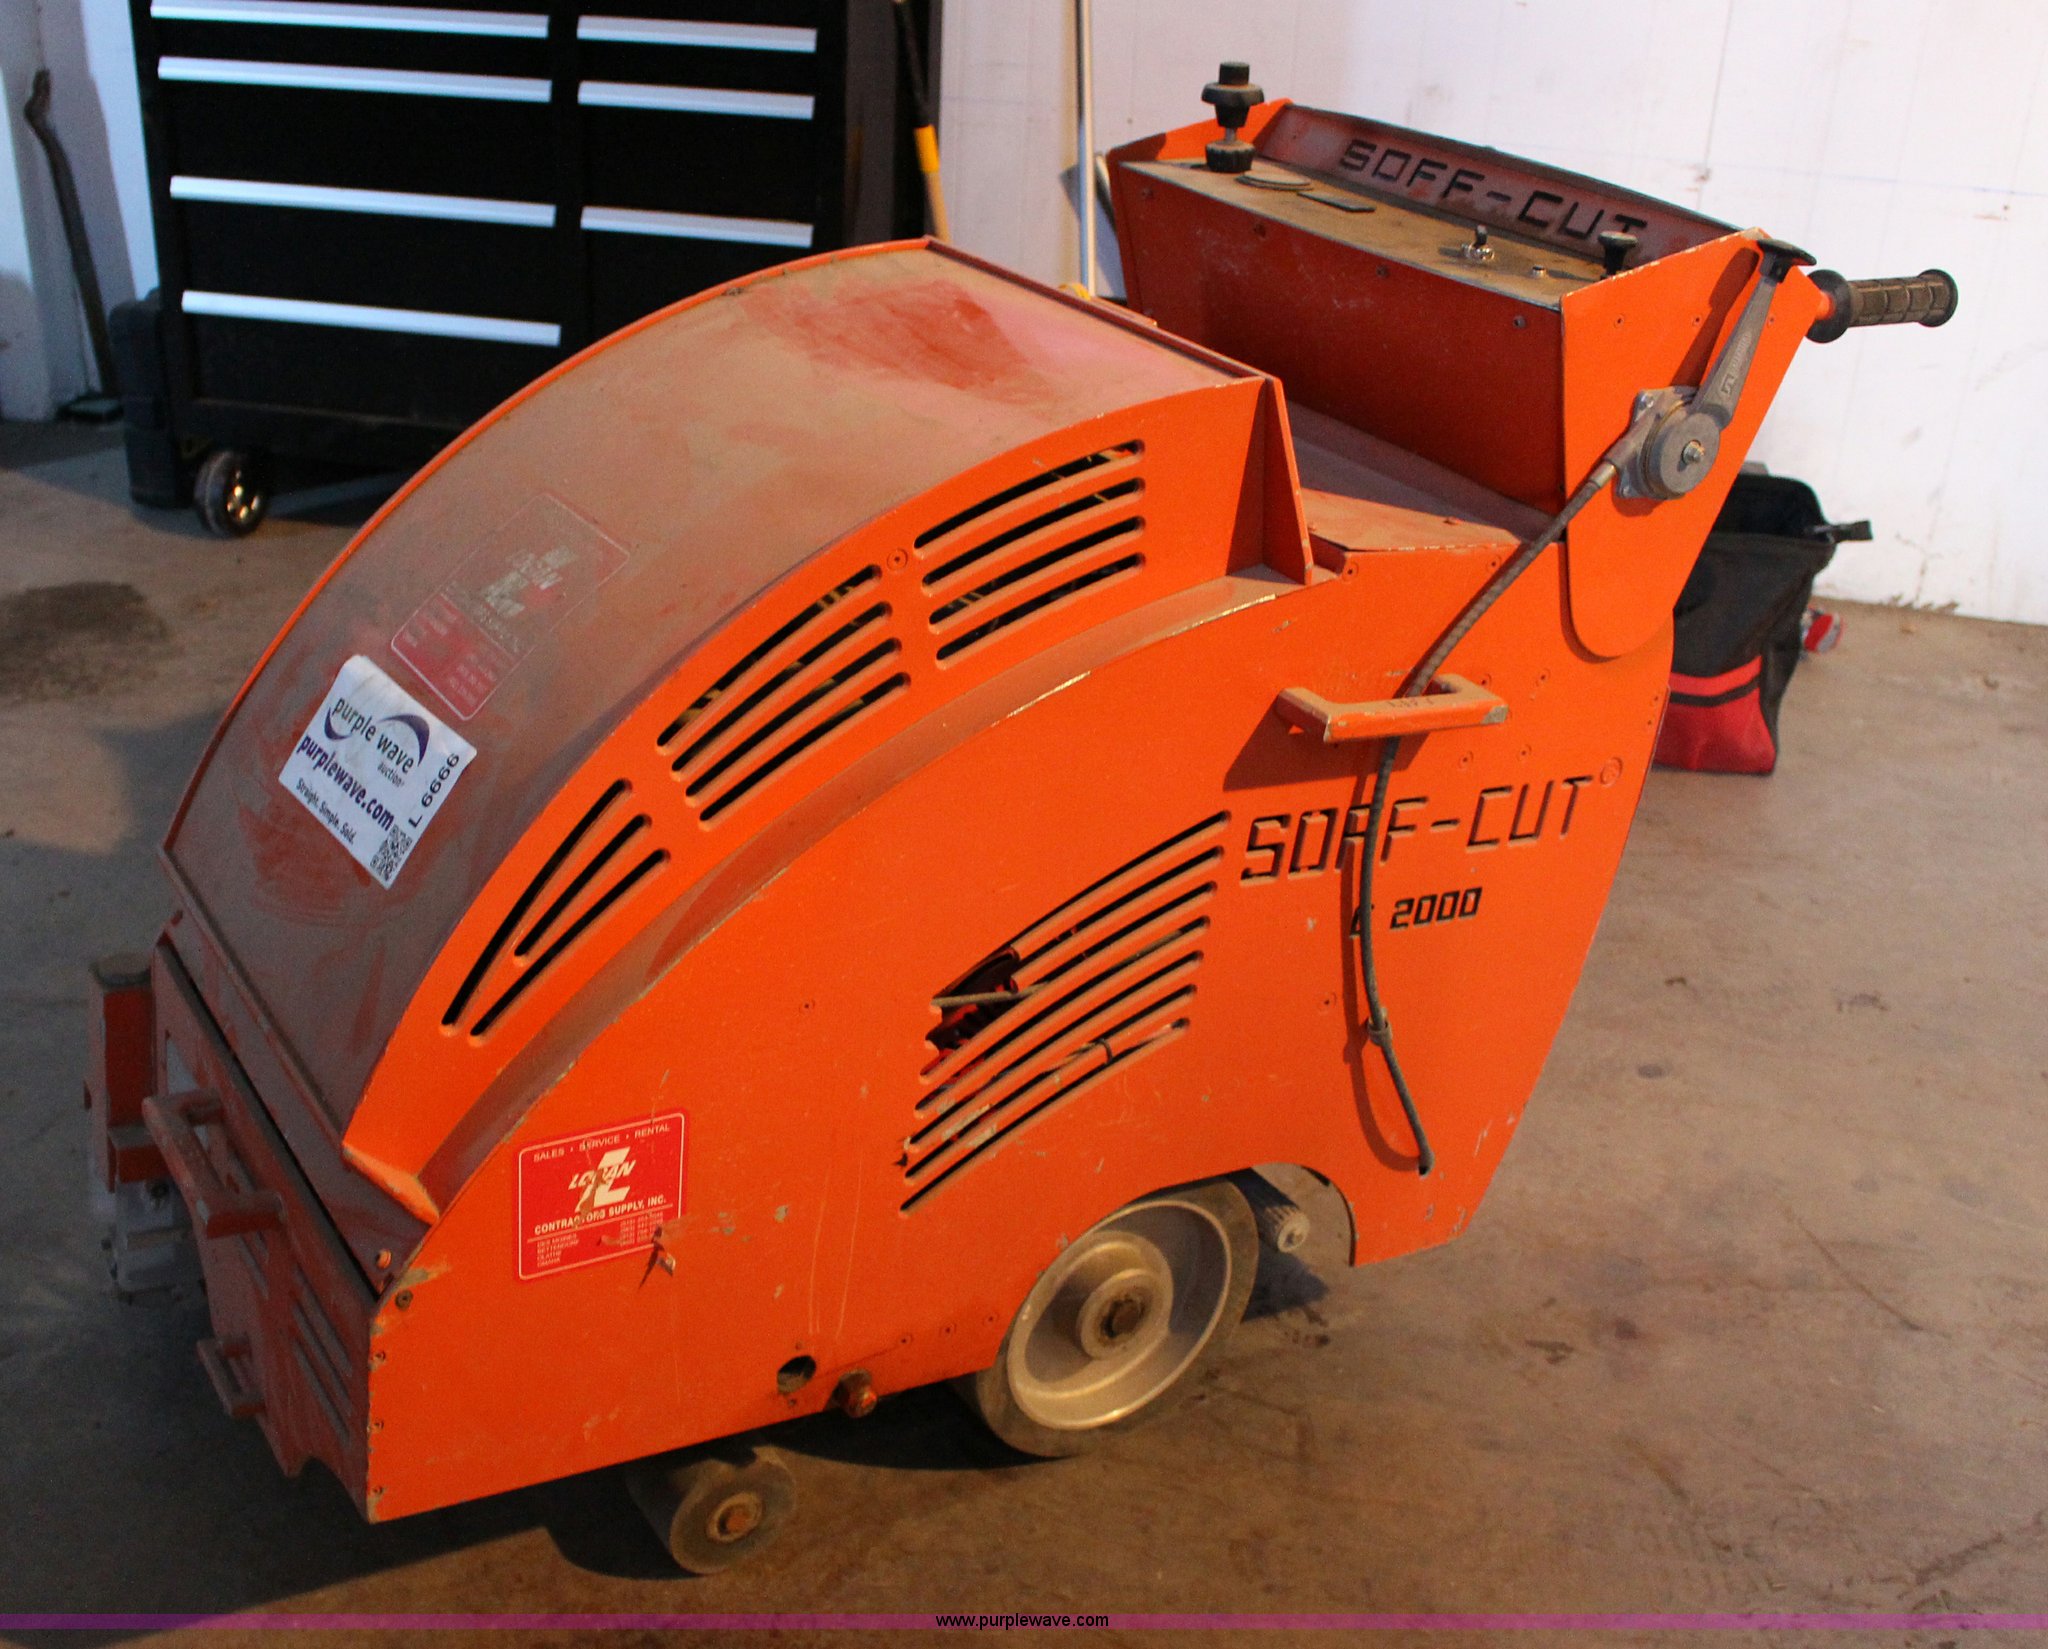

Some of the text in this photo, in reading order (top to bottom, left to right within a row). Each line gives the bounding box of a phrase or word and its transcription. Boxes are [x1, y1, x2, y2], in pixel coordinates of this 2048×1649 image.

[331, 697, 415, 774] purple wave
[296, 733, 395, 832] purplewave.com
[408, 815, 423, 829] L
[1240, 775, 1594, 885] SOFF-CUT
[1389, 886, 1483, 931] 2000
[533, 1123, 670, 1163] SALES SERVICE RENTAL
[608, 1199, 645, 1218] SUPPLY,
[647, 1194, 667, 1206] INC.
